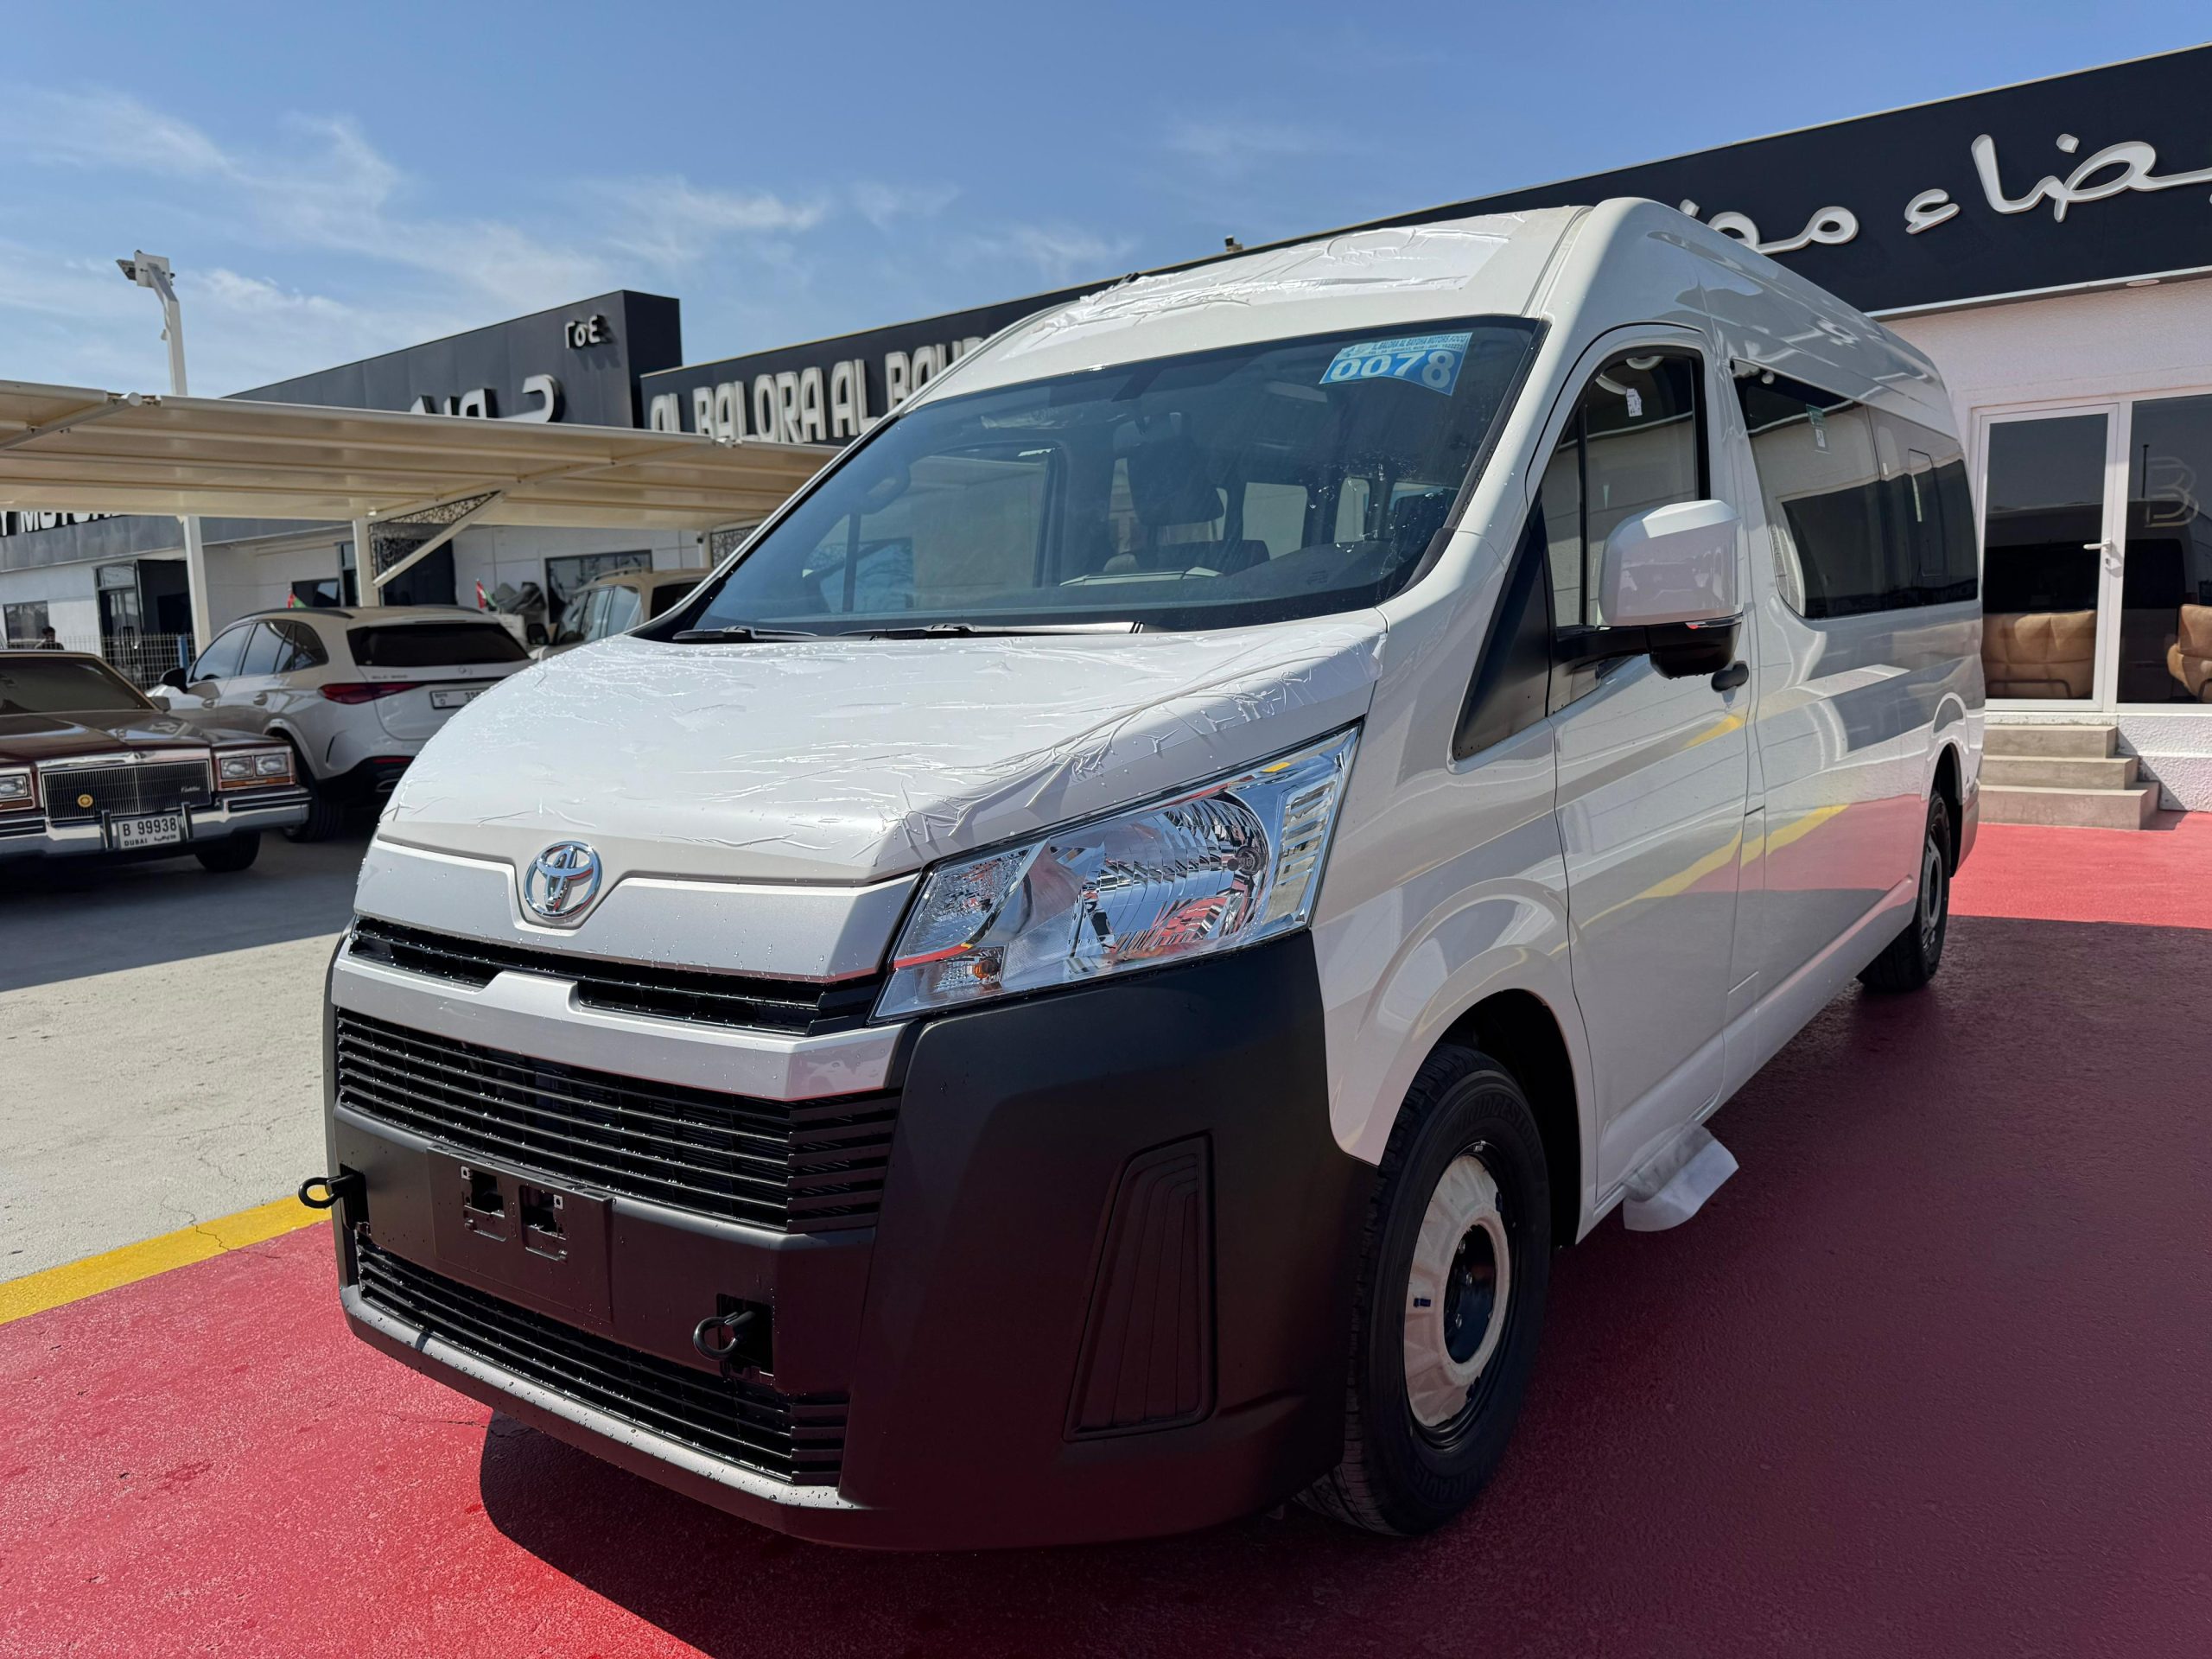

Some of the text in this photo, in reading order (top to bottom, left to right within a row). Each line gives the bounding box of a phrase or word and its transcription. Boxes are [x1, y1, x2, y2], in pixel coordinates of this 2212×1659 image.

[1330, 350, 1455, 389] 0078
[693, 366, 827, 443] BALORA
[830, 359, 881, 438] AL
[123, 817, 177, 836] B 99938
